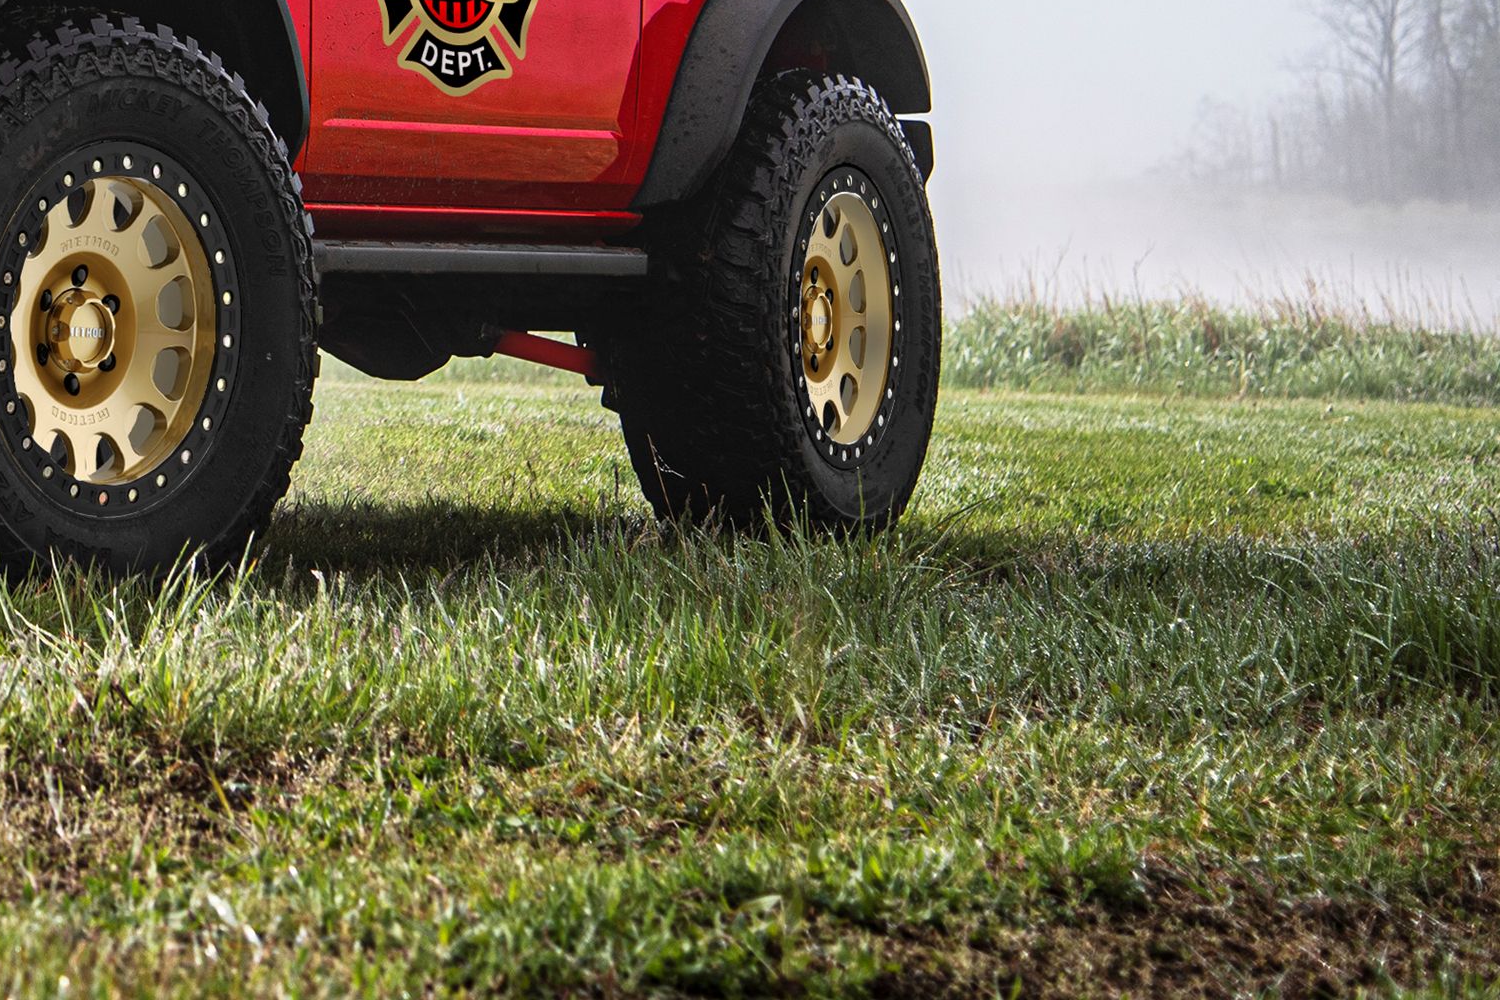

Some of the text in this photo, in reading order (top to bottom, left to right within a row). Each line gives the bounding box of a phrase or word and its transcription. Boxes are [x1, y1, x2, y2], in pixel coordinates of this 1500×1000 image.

[420, 39, 493, 77] DEPT.
[86, 87, 286, 277] MICKEY THOMPSON
